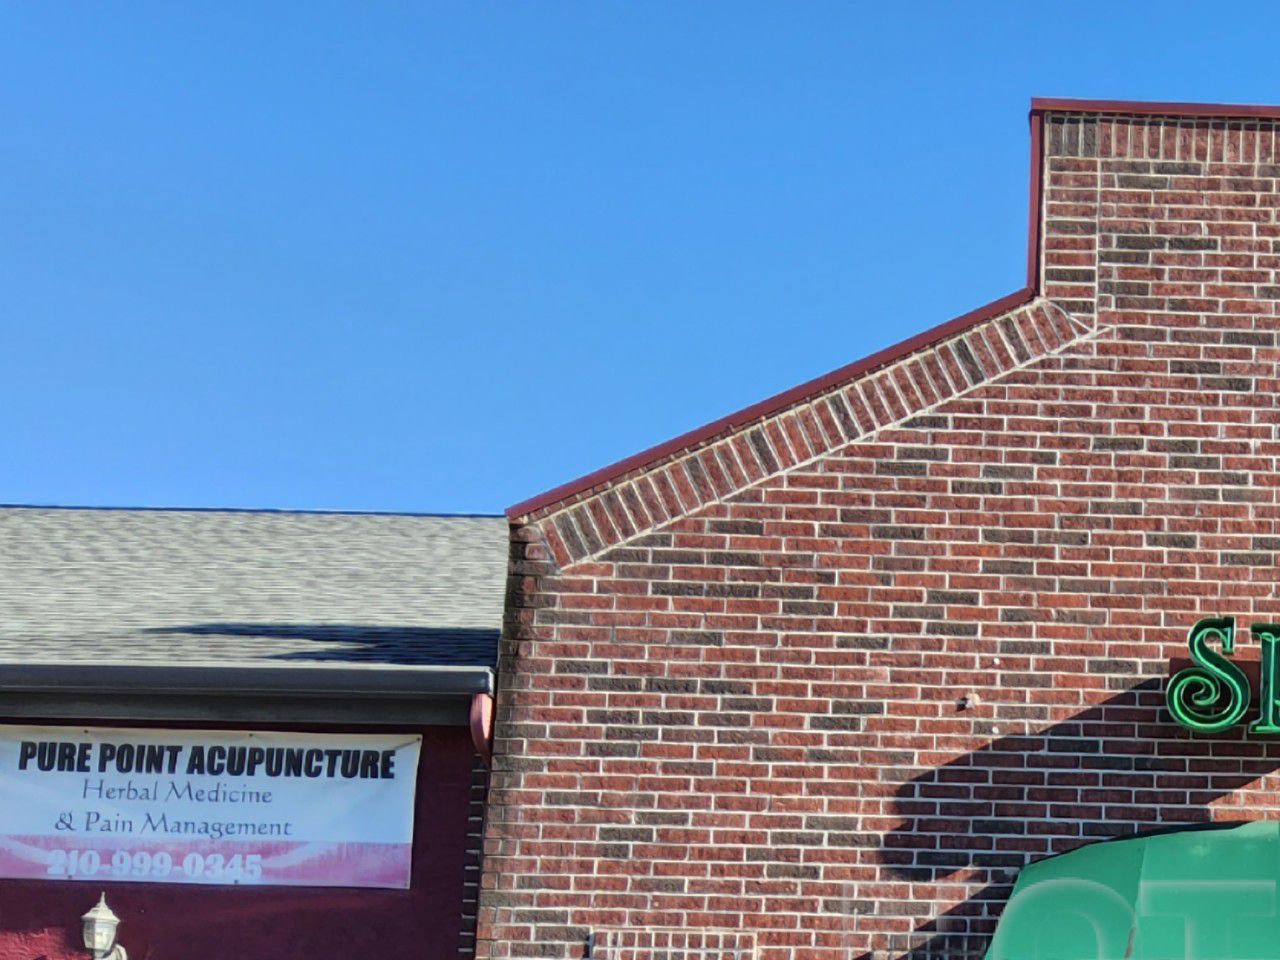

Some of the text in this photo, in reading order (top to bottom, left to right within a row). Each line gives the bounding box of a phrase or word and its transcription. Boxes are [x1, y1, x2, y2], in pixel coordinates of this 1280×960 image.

[18, 741, 395, 779] PURE POINT ACUPUNCTURE
[82, 779, 273, 804] Herbal Medicine
[54, 811, 293, 839] & Pain Management
[46, 849, 262, 880] 210-999-0345
